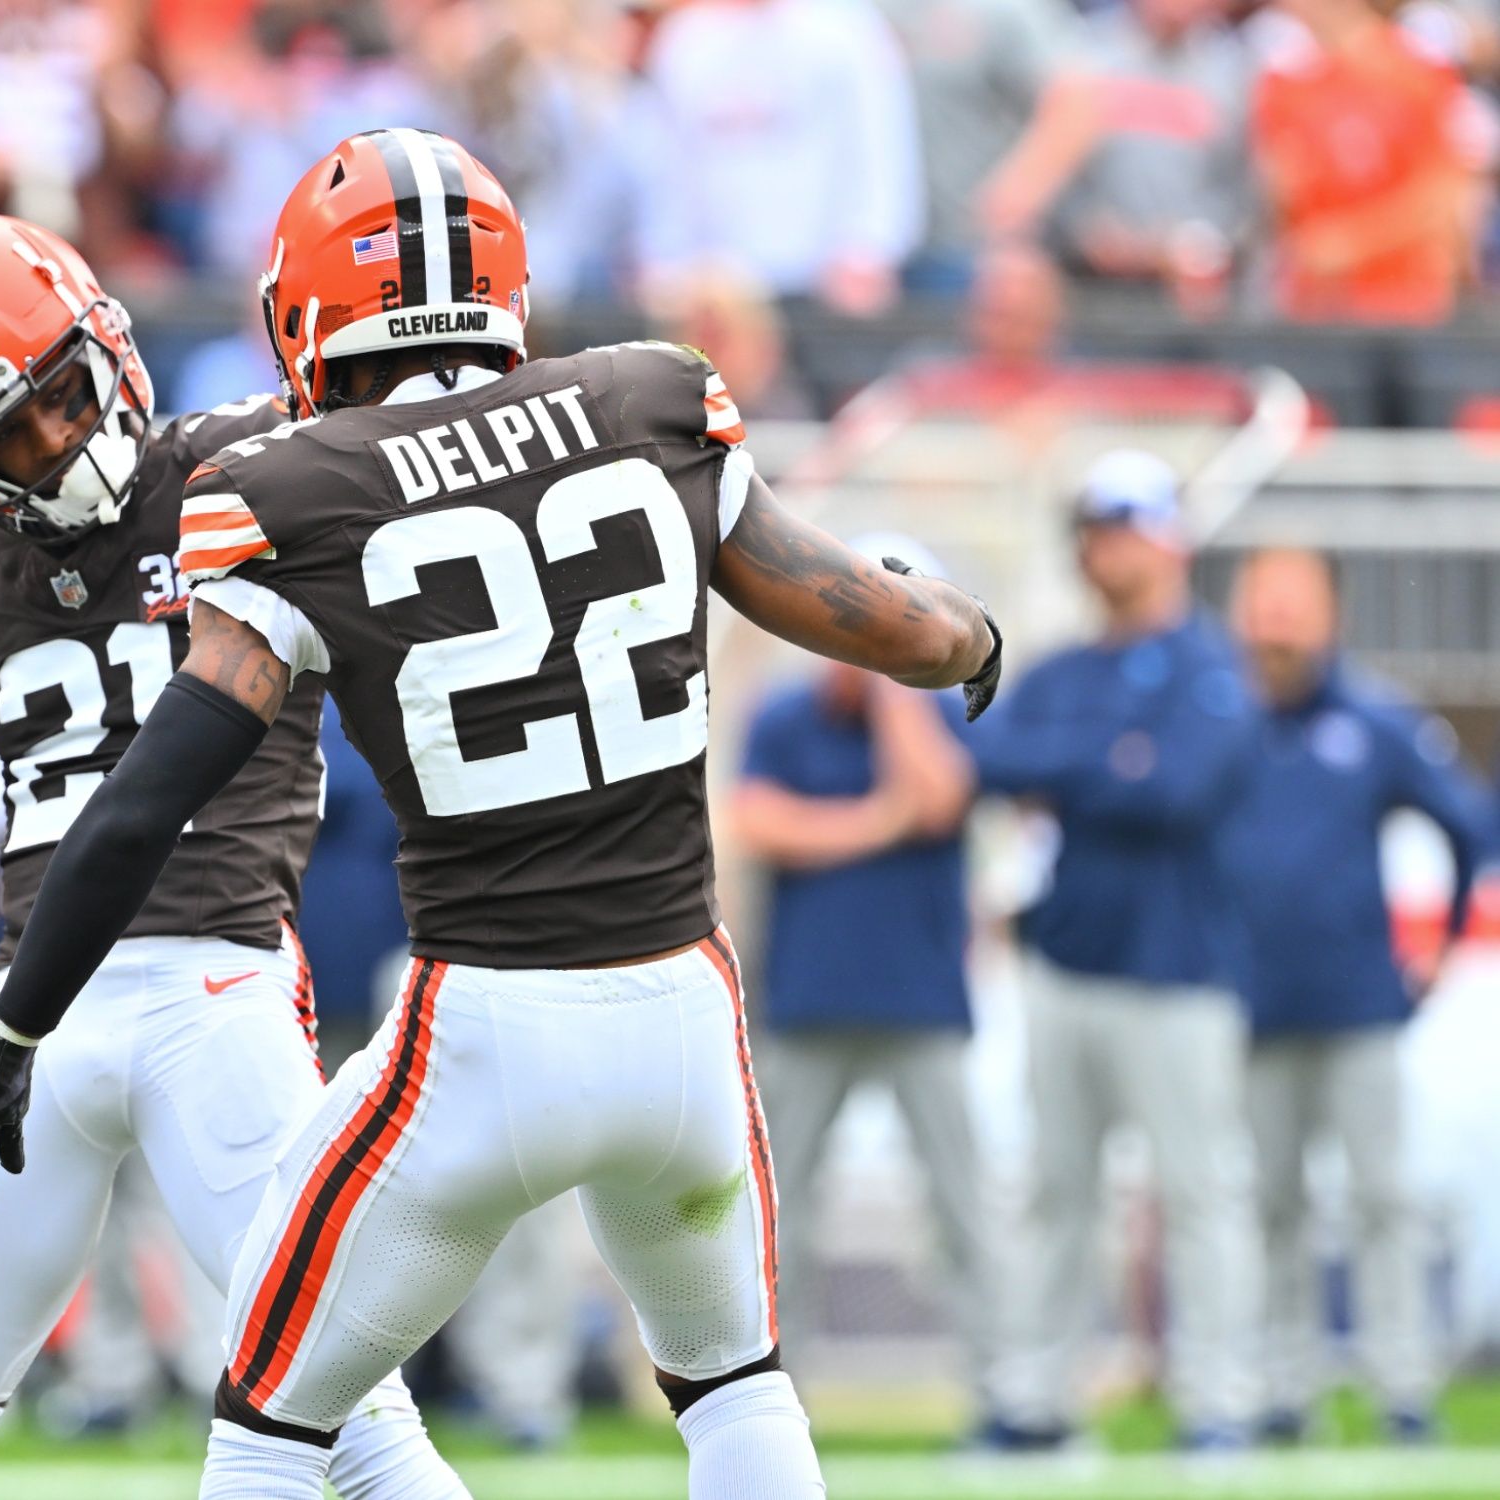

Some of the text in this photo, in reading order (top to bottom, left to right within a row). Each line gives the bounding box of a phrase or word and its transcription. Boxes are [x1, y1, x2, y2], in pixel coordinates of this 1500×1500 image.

[388, 312, 489, 338] CLEVELAND
[378, 384, 600, 504] DELPIT
[361, 457, 708, 817] 22
